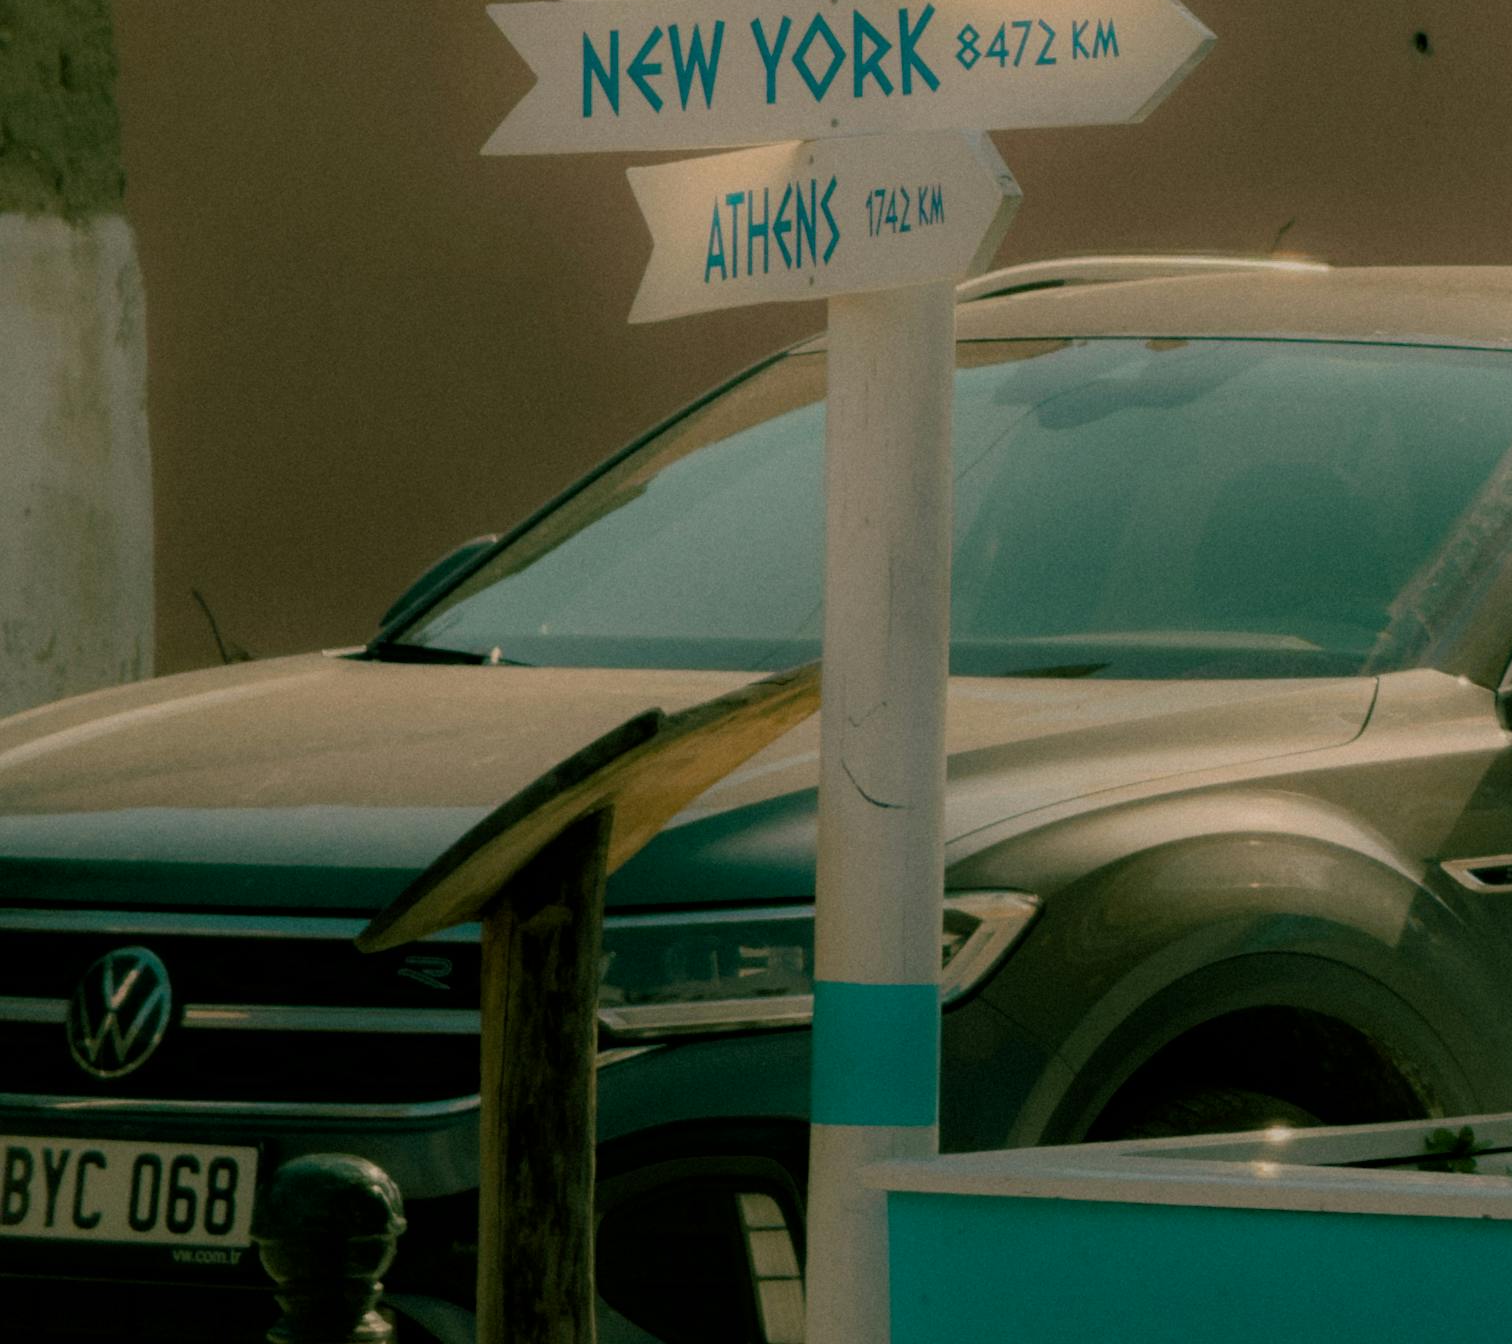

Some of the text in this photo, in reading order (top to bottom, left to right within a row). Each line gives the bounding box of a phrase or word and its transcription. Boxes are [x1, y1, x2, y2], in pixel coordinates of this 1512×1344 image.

[583, 3, 1120, 117] NEW YORK 8472 KM
[704, 174, 945, 283] ATHENS 1742 KM
[1, 1145, 240, 1236] BYC 068
